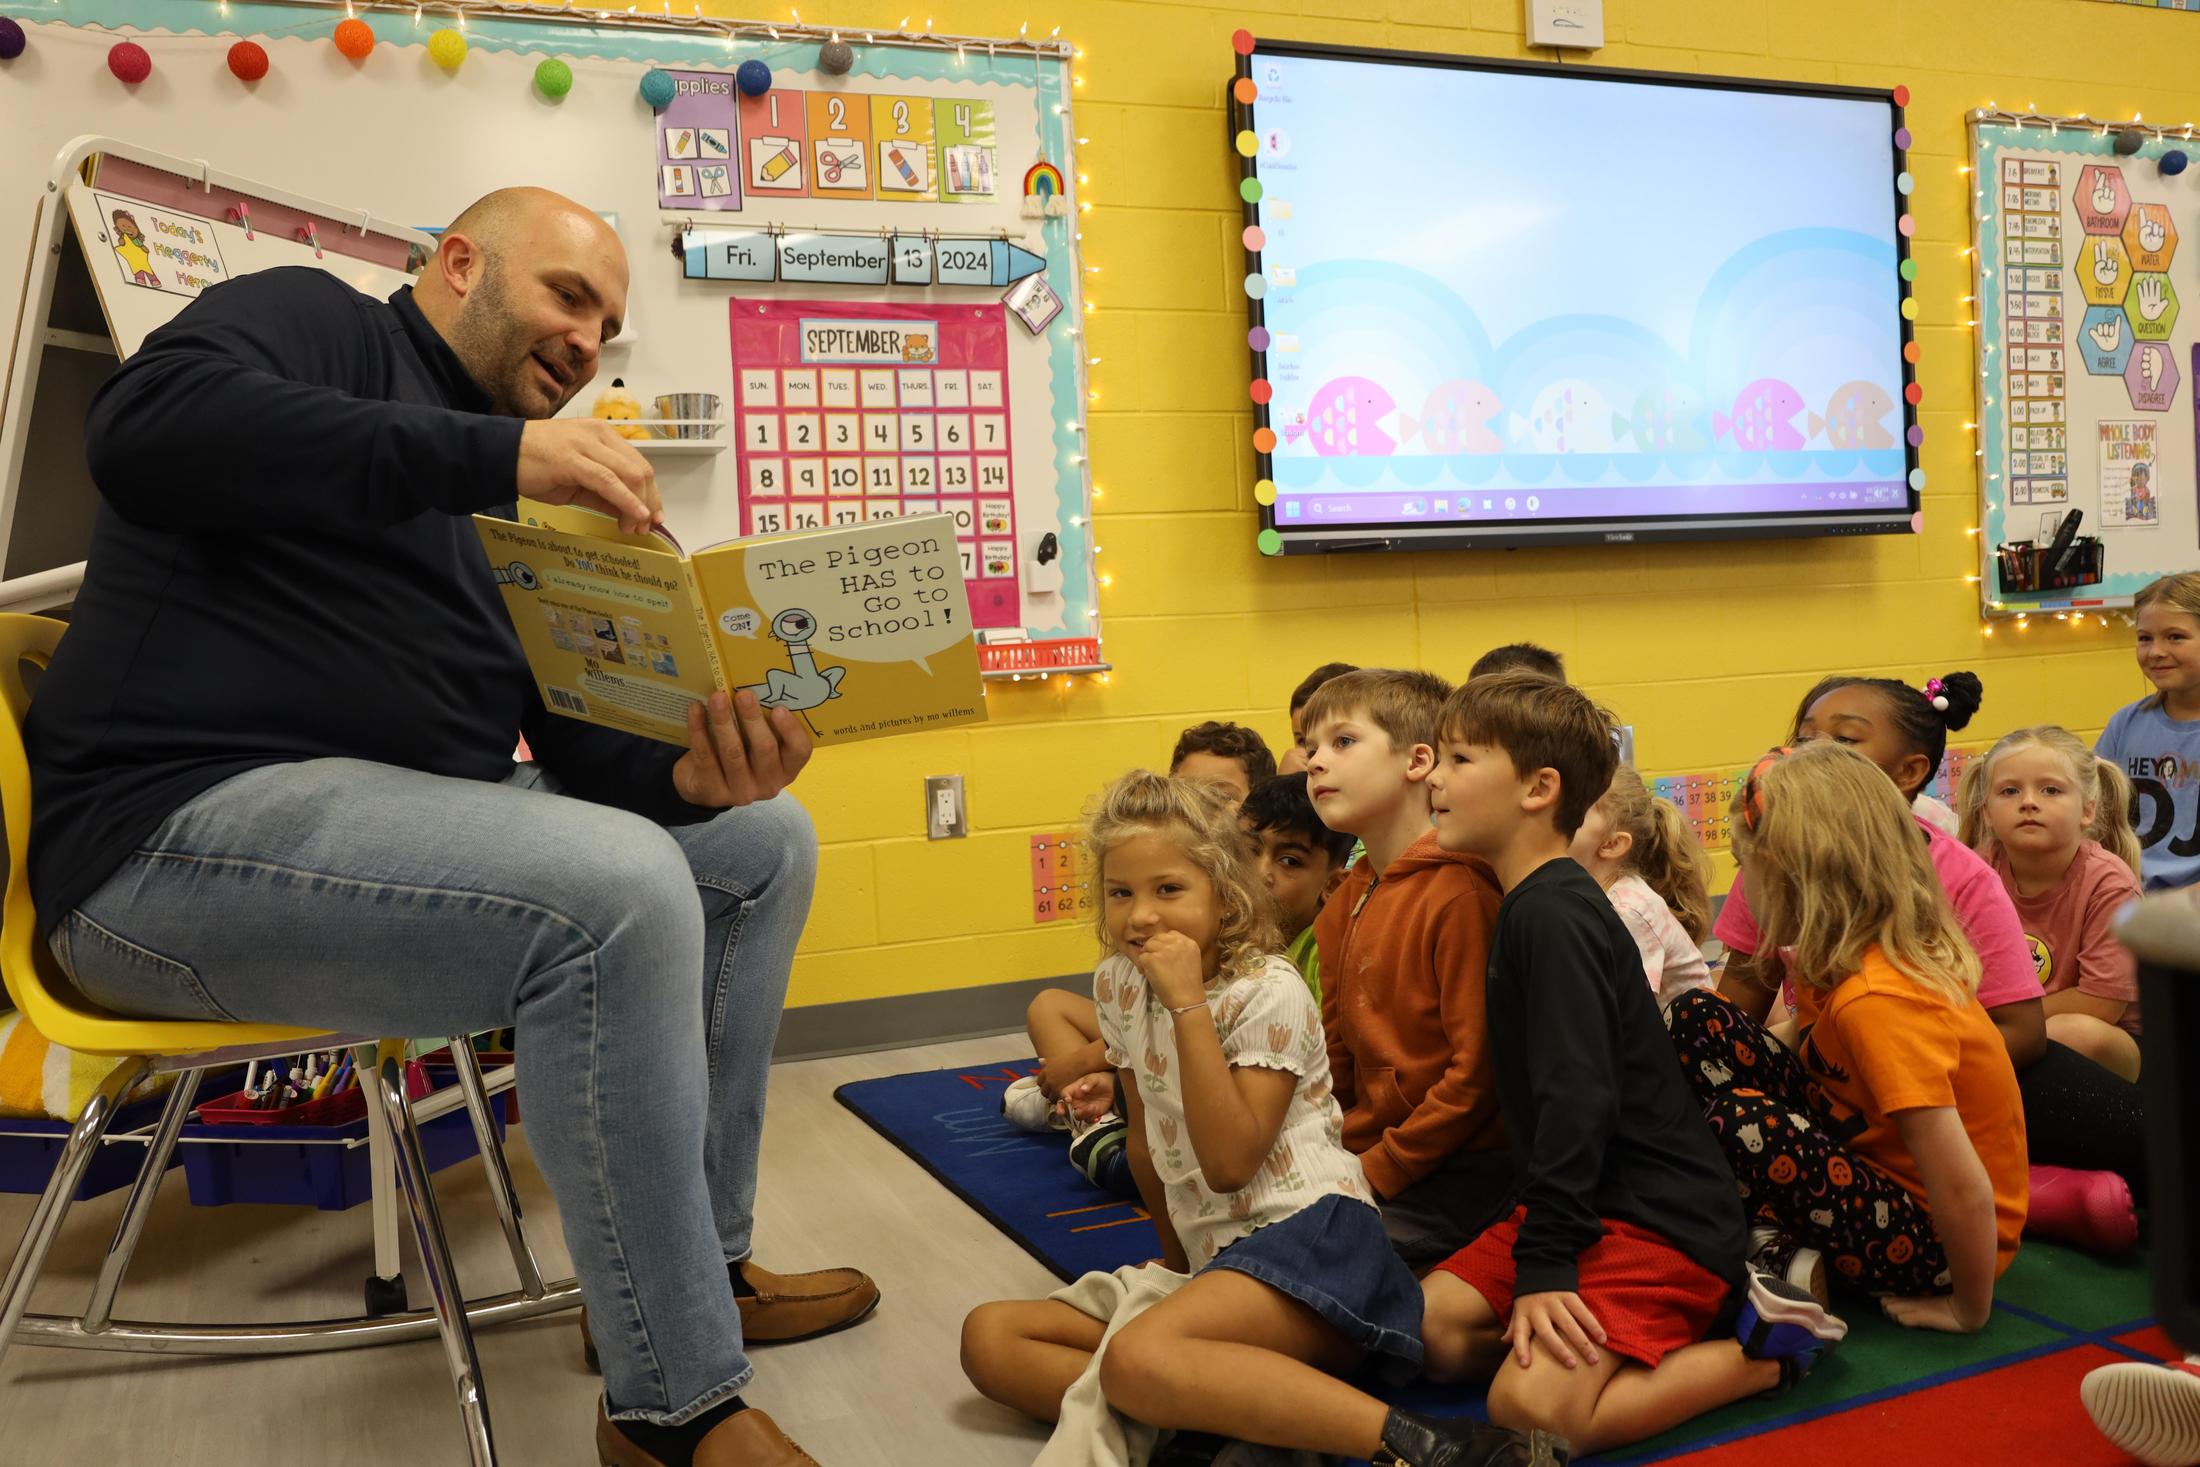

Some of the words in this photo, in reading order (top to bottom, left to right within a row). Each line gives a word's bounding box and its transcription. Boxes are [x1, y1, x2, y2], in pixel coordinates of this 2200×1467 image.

[674, 76, 730, 97] pplies
[770, 95, 778, 128] 1
[828, 96, 848, 131] 2
[892, 100, 910, 134] 3
[954, 104, 971, 137] 4
[151, 217, 203, 244] Today's
[2087, 216, 2119, 228] BATHROOM
[153, 242, 219, 273] Heggerty
[726, 245, 756, 265] Fri.
[784, 246, 887, 271] September
[904, 249, 923, 269] 13
[942, 251, 988, 271] 2024
[2141, 255, 2160, 265] WATER
[2095, 287, 2114, 299] TISSUE
[2138, 323, 2166, 334] QUESTION
[807, 329, 901, 354] SEPTEMBER
[2097, 357, 2116, 369] AGREE
[749, 382, 769, 390] SUN.
[828, 383, 850, 391] TUES.
[868, 383, 888, 391] WED.
[902, 383, 930, 391] THURS.
[944, 383, 960, 391] FRI.
[977, 383, 994, 391] SAT.
[2138, 391, 2165, 404] DISAGREE
[757, 425, 767, 443] 1
[797, 425, 809, 443] 2
[837, 425, 848, 443] 3
[874, 425, 887, 443] 4
[912, 425, 923, 443] 5
[947, 425, 959, 443] 6
[984, 425, 994, 442] 7
[2099, 424, 2130, 441] WHOLE
[2132, 424, 2155, 441] BODY
[2107, 442, 2151, 460] LISTENING
[760, 469, 773, 488] 8
[801, 469, 814, 488] 9
[831, 468, 858, 487] 10
[873, 468, 893, 486] 11
[909, 467, 930, 485] 12
[945, 467, 967, 485] 13
[983, 467, 1004, 485] 14
[1327, 504, 1352, 513] Search
[758, 514, 780, 533] 15
[795, 514, 818, 529] 16
[489, 528, 508, 542] The
[509, 532, 537, 548] Pigeon
[547, 540, 573, 555] about
[585, 550, 599, 563] get
[759, 558, 816, 581] The
[826, 537, 941, 568] Pigeon
[563, 557, 575, 569] Do
[575, 559, 595, 573] YOU
[594, 562, 618, 579] think
[633, 571, 662, 588] should
[664, 579, 679, 592] go?
[840, 570, 897, 595] HAS
[909, 564, 944, 583] to
[864, 596, 901, 614] Go
[913, 587, 949, 605] to
[723, 612, 752, 624] Come
[730, 620, 752, 632] ON!
[585, 657, 600, 669] Mo
[833, 724, 858, 736] words
[860, 722, 876, 732] and
[878, 717, 912, 730] pictures
[913, 714, 924, 724] by
[927, 713, 940, 721] mo
[942, 706, 975, 718] willems
[1951, 767, 1961, 776] 55
[1689, 793, 1700, 804] 37
[1705, 792, 1716, 803] 38
[1720, 791, 1731, 802] 39
[1705, 830, 1717, 840] 98
[1040, 858, 1044, 869] 1
[1061, 855, 1067, 867] 2
[1038, 900, 1050, 912] 61
[1058, 898, 1072, 910] 62
